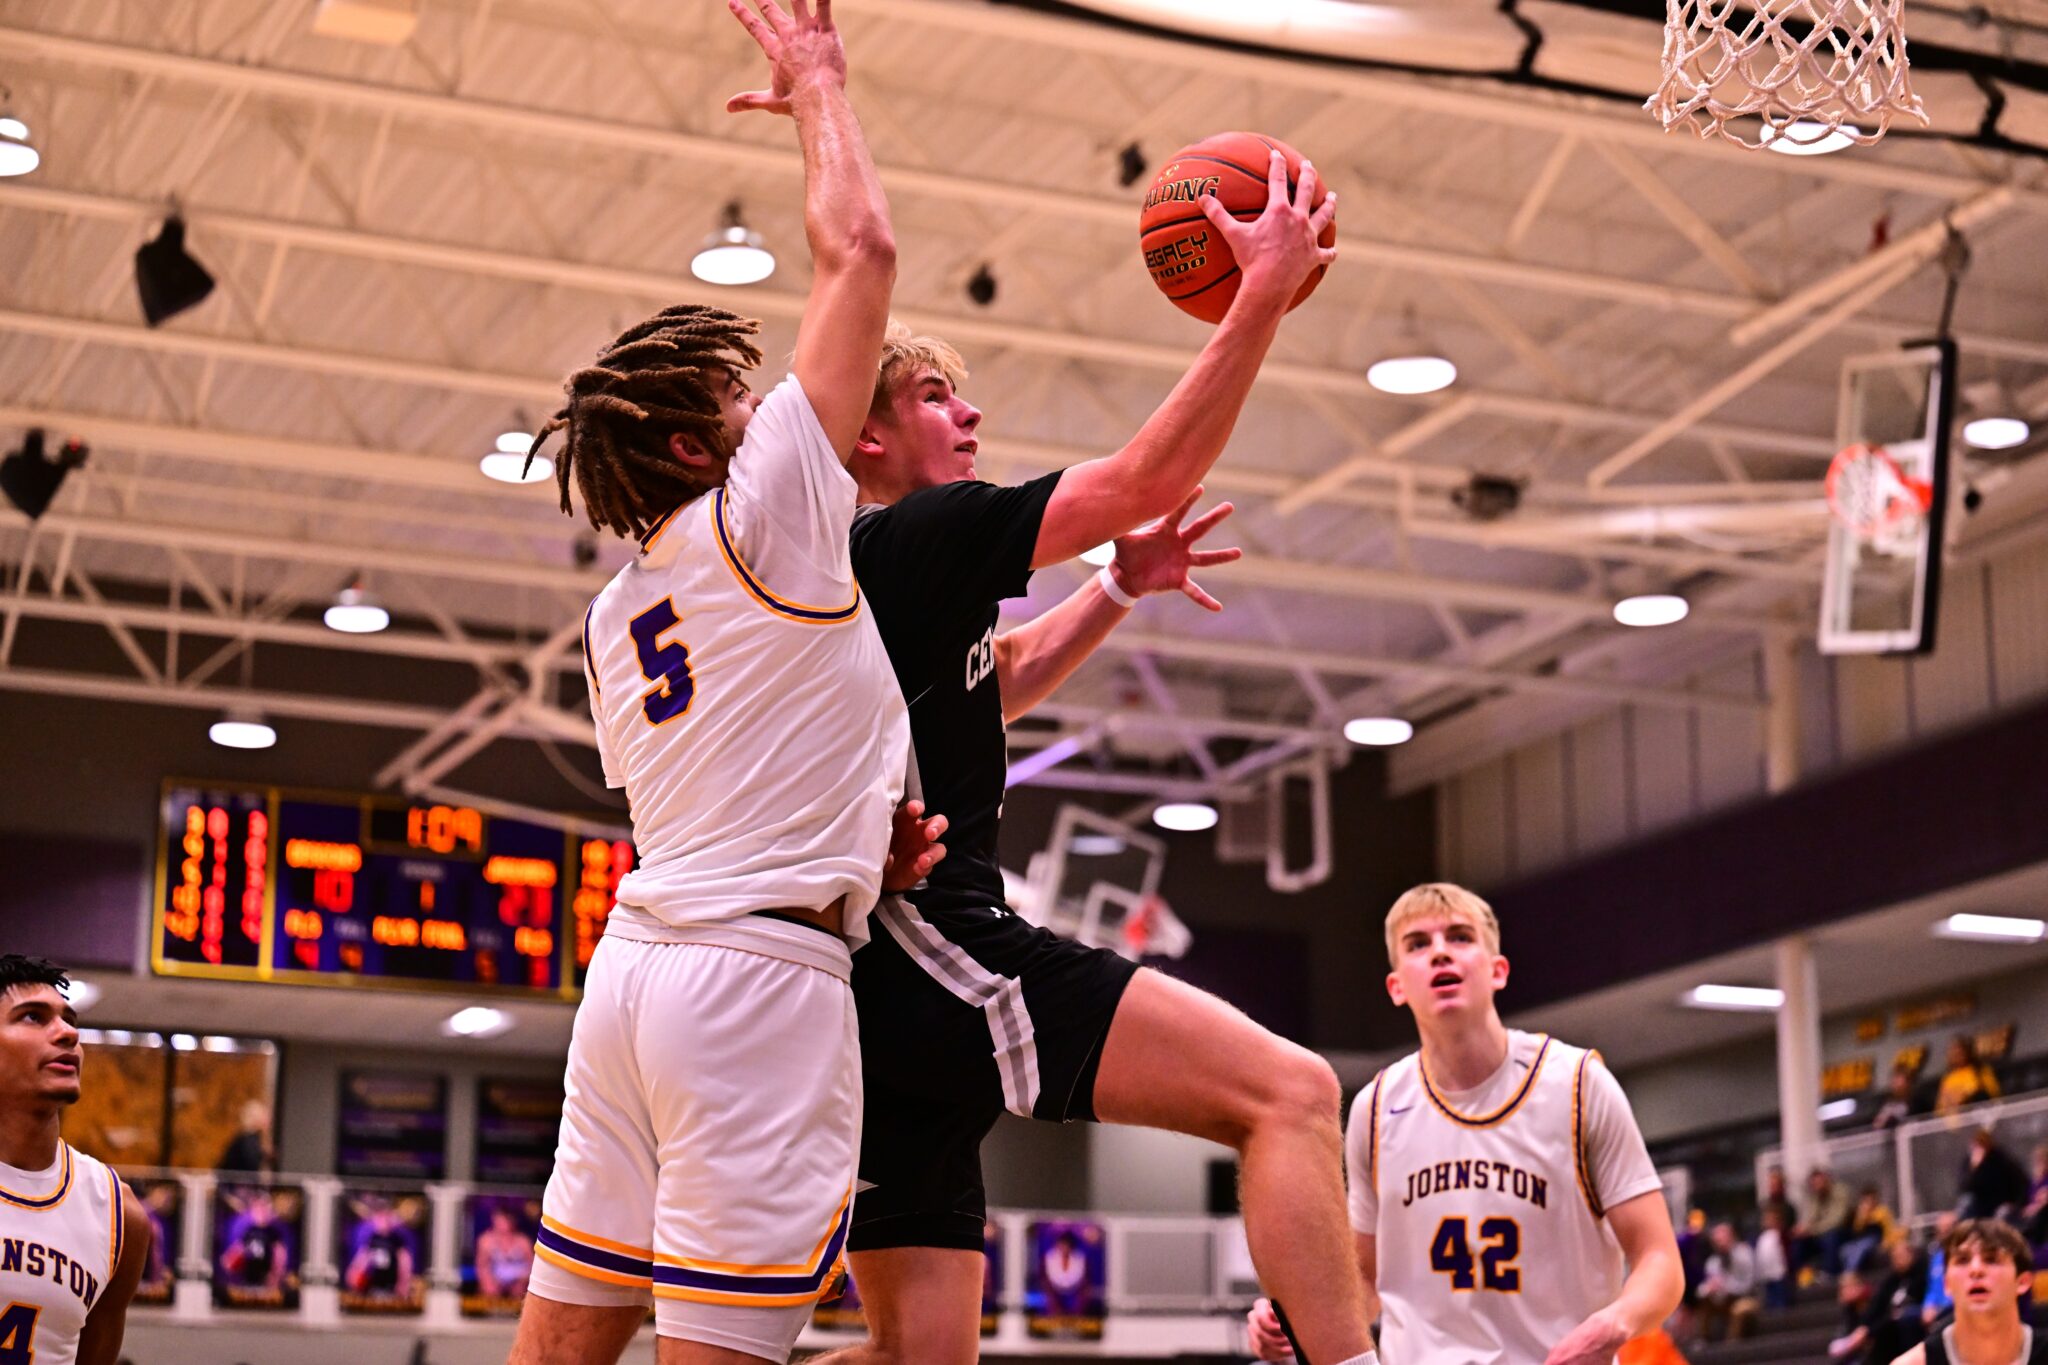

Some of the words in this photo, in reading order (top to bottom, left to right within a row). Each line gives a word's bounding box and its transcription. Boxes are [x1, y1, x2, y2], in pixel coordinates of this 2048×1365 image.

[1145, 230, 1209, 268] EGACY
[628, 593, 697, 728] 5
[1403, 1160, 1547, 1209] JOHNSTON
[1, 1237, 99, 1312] NSTON
[1430, 1216, 1521, 1293] 42
